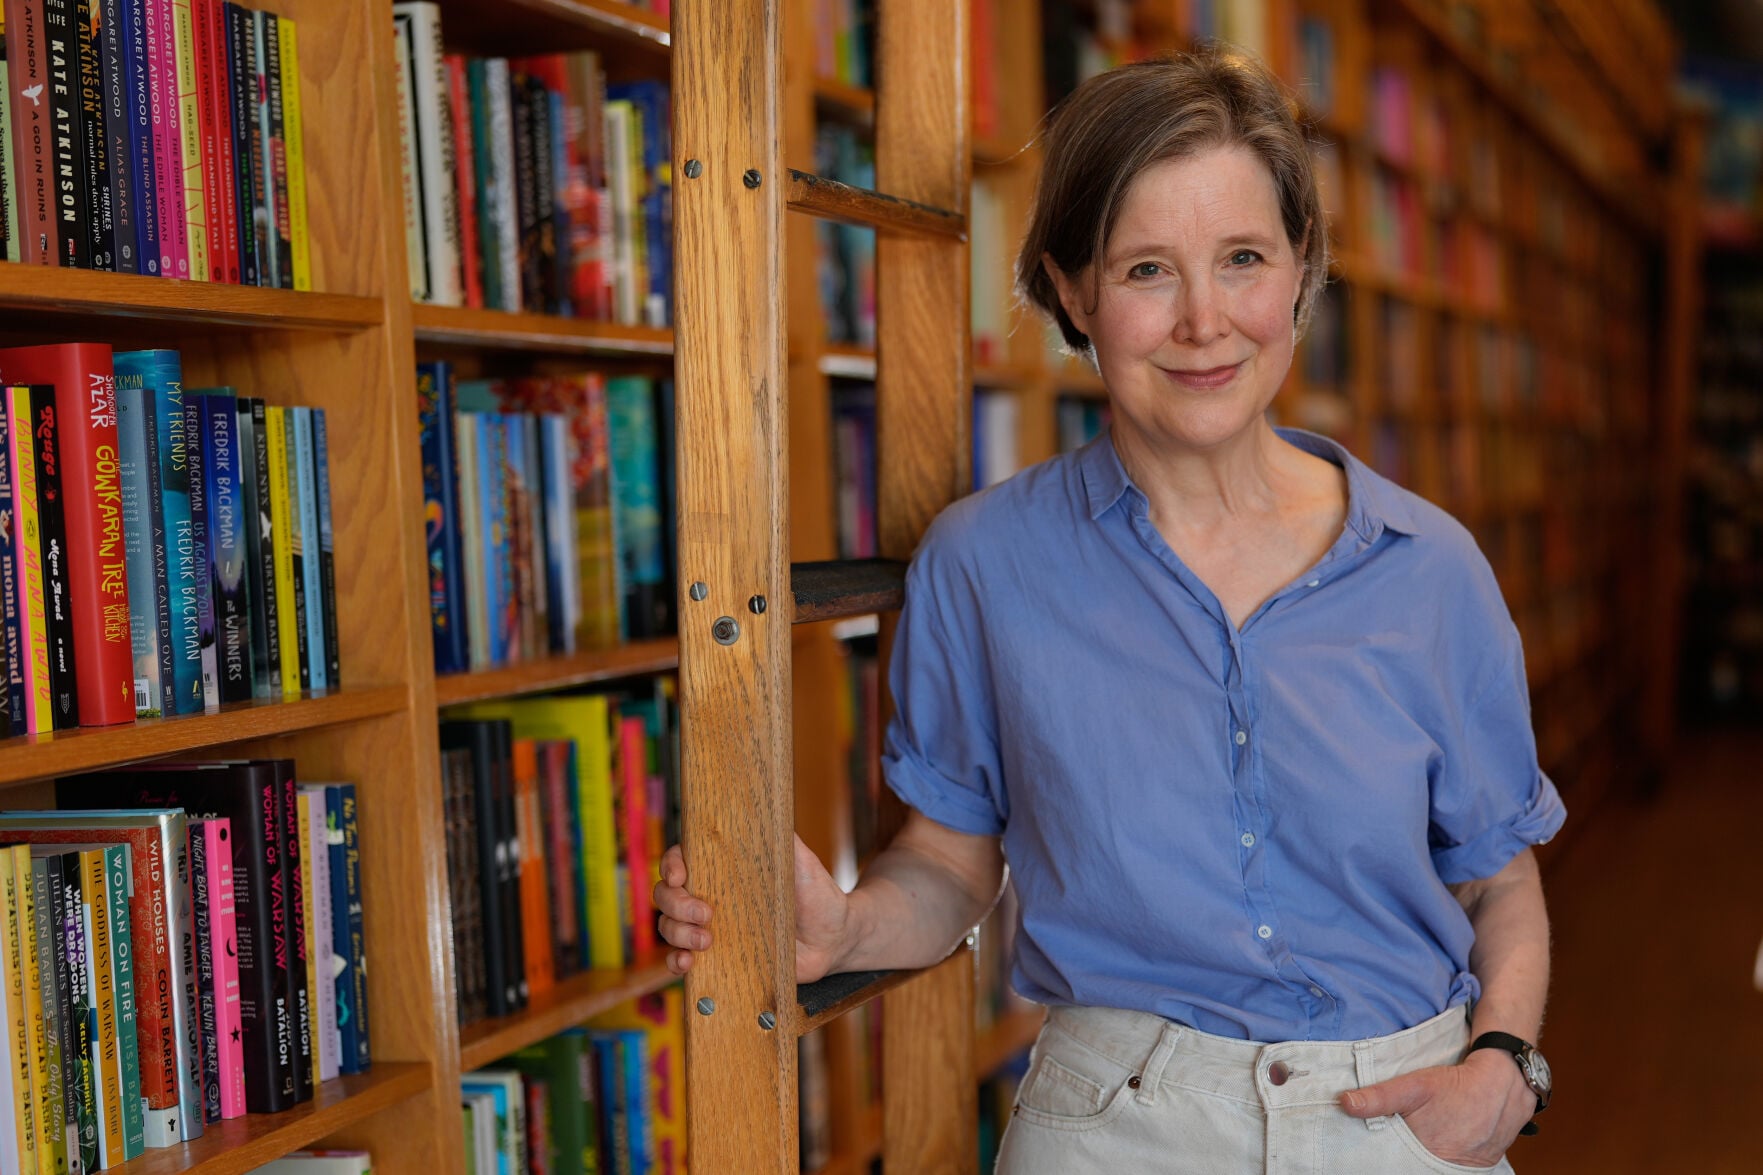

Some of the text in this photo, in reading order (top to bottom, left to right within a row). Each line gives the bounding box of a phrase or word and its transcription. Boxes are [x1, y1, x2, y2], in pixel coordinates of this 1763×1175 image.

[25, 6, 37, 78] ATKINSON
[48, 12, 66, 27] LIFE
[267, 18, 280, 73] MARGARET
[52, 39, 67, 96] KATE
[79, 21, 95, 112] ATKINSON
[107, 0, 120, 118] RGARET ATWOOD
[133, 0, 147, 126] ARGARET ATWOOD
[146, 0, 160, 125] ARGARET ATWOOD
[163, 0, 177, 129] ARGARET ATWOOD
[233, 13, 246, 140] MARGARET ATWOOD
[245, 18, 259, 123] MARGARET ATWOOD
[187, 104, 196, 156] HAG-SEED
[270, 77, 282, 121] ATWOOD
[32, 110, 46, 222] A GOD IN RUINS
[57, 107, 76, 222] ATKINSON
[88, 120, 96, 158] normal
[91, 160, 99, 187] rules
[116, 136, 128, 226] ALIAS GRACE
[143, 157, 151, 189] BLIND
[157, 156, 165, 193] EDIBLE
[93, 215, 103, 244] apply
[103, 186, 112, 230] SHRINES
[145, 193, 154, 241] ASSASSIN
[159, 197, 168, 241] WOMAN
[176, 200, 184, 245] WOMAN
[89, 373, 109, 429] AZAR
[166, 381, 187, 472] MY FRIENDS
[16, 417, 38, 513] BUNNY
[38, 405, 55, 476] Rouge
[185, 404, 203, 512] FREDRIK BACKMAN
[257, 434, 269, 506] KING NYX
[0, 452, 11, 499] well
[94, 445, 122, 557] GOWKARAN
[213, 412, 235, 549] FREDRIK BACKMAN
[154, 527, 162, 537] A
[154, 544, 166, 578] MAN
[193, 521, 205, 537] US
[3, 555, 15, 618] mona
[48, 538, 64, 621] Mona Awad
[101, 560, 125, 600] TREE
[176, 520, 201, 660] FREDRIK BACKMAN
[195, 541, 208, 588] AGAINST
[24, 544, 50, 702] MONA AWAD
[103, 605, 121, 643] KITCHEN
[158, 585, 170, 639] CALLED
[264, 554, 278, 661] KIRSTEN BAKIS
[7, 626, 23, 685] awad
[58, 637, 67, 673] a novel
[162, 645, 171, 674] OVE
[225, 614, 242, 682] WINNERS
[263, 785, 275, 841] WOMAN
[177, 842, 188, 885] TRIP
[266, 847, 277, 866] OF
[284, 777, 307, 961] WOMAN OF WARSAW
[149, 839, 165, 955] WILD HOUSES
[193, 834, 213, 982] NIGHT BOAT TO TANGIER
[271, 869, 287, 970] WARSAW
[36, 872, 55, 1020] JULIAN BARNES
[50, 872, 67, 991] JULIAN BARNES
[65, 884, 80, 1005] WERE DRAGONS
[74, 888, 87, 995] WHEN WOMEN
[93, 860, 114, 1061] THE GODDESS OF WARSAW
[113, 853, 132, 1023] WOMAN ON FIRE
[183, 932, 193, 976] AMIE
[61, 994, 69, 1016] The
[63, 1020, 73, 1050] Sense
[157, 969, 175, 1094] COLIN BARRETT
[203, 994, 219, 1074] KEVIN BARRY
[276, 998, 288, 1066] BATALION
[298, 989, 309, 1056] BATALION
[18, 1019, 29, 1080] JULIAN
[35, 1013, 47, 1074] JULIAN
[41, 1085, 51, 1144] BARNES
[66, 1053, 72, 1065] of
[66, 1067, 73, 1081] an
[79, 1022, 92, 1116] KELLY BARNHILL
[124, 1035, 138, 1126] LISA BARR
[48, 1026, 63, 1142] The Only Story
[67, 1083, 75, 1123] Ending
[107, 1076, 118, 1136] LISA BARR
[23, 1091, 34, 1152] BARNES
